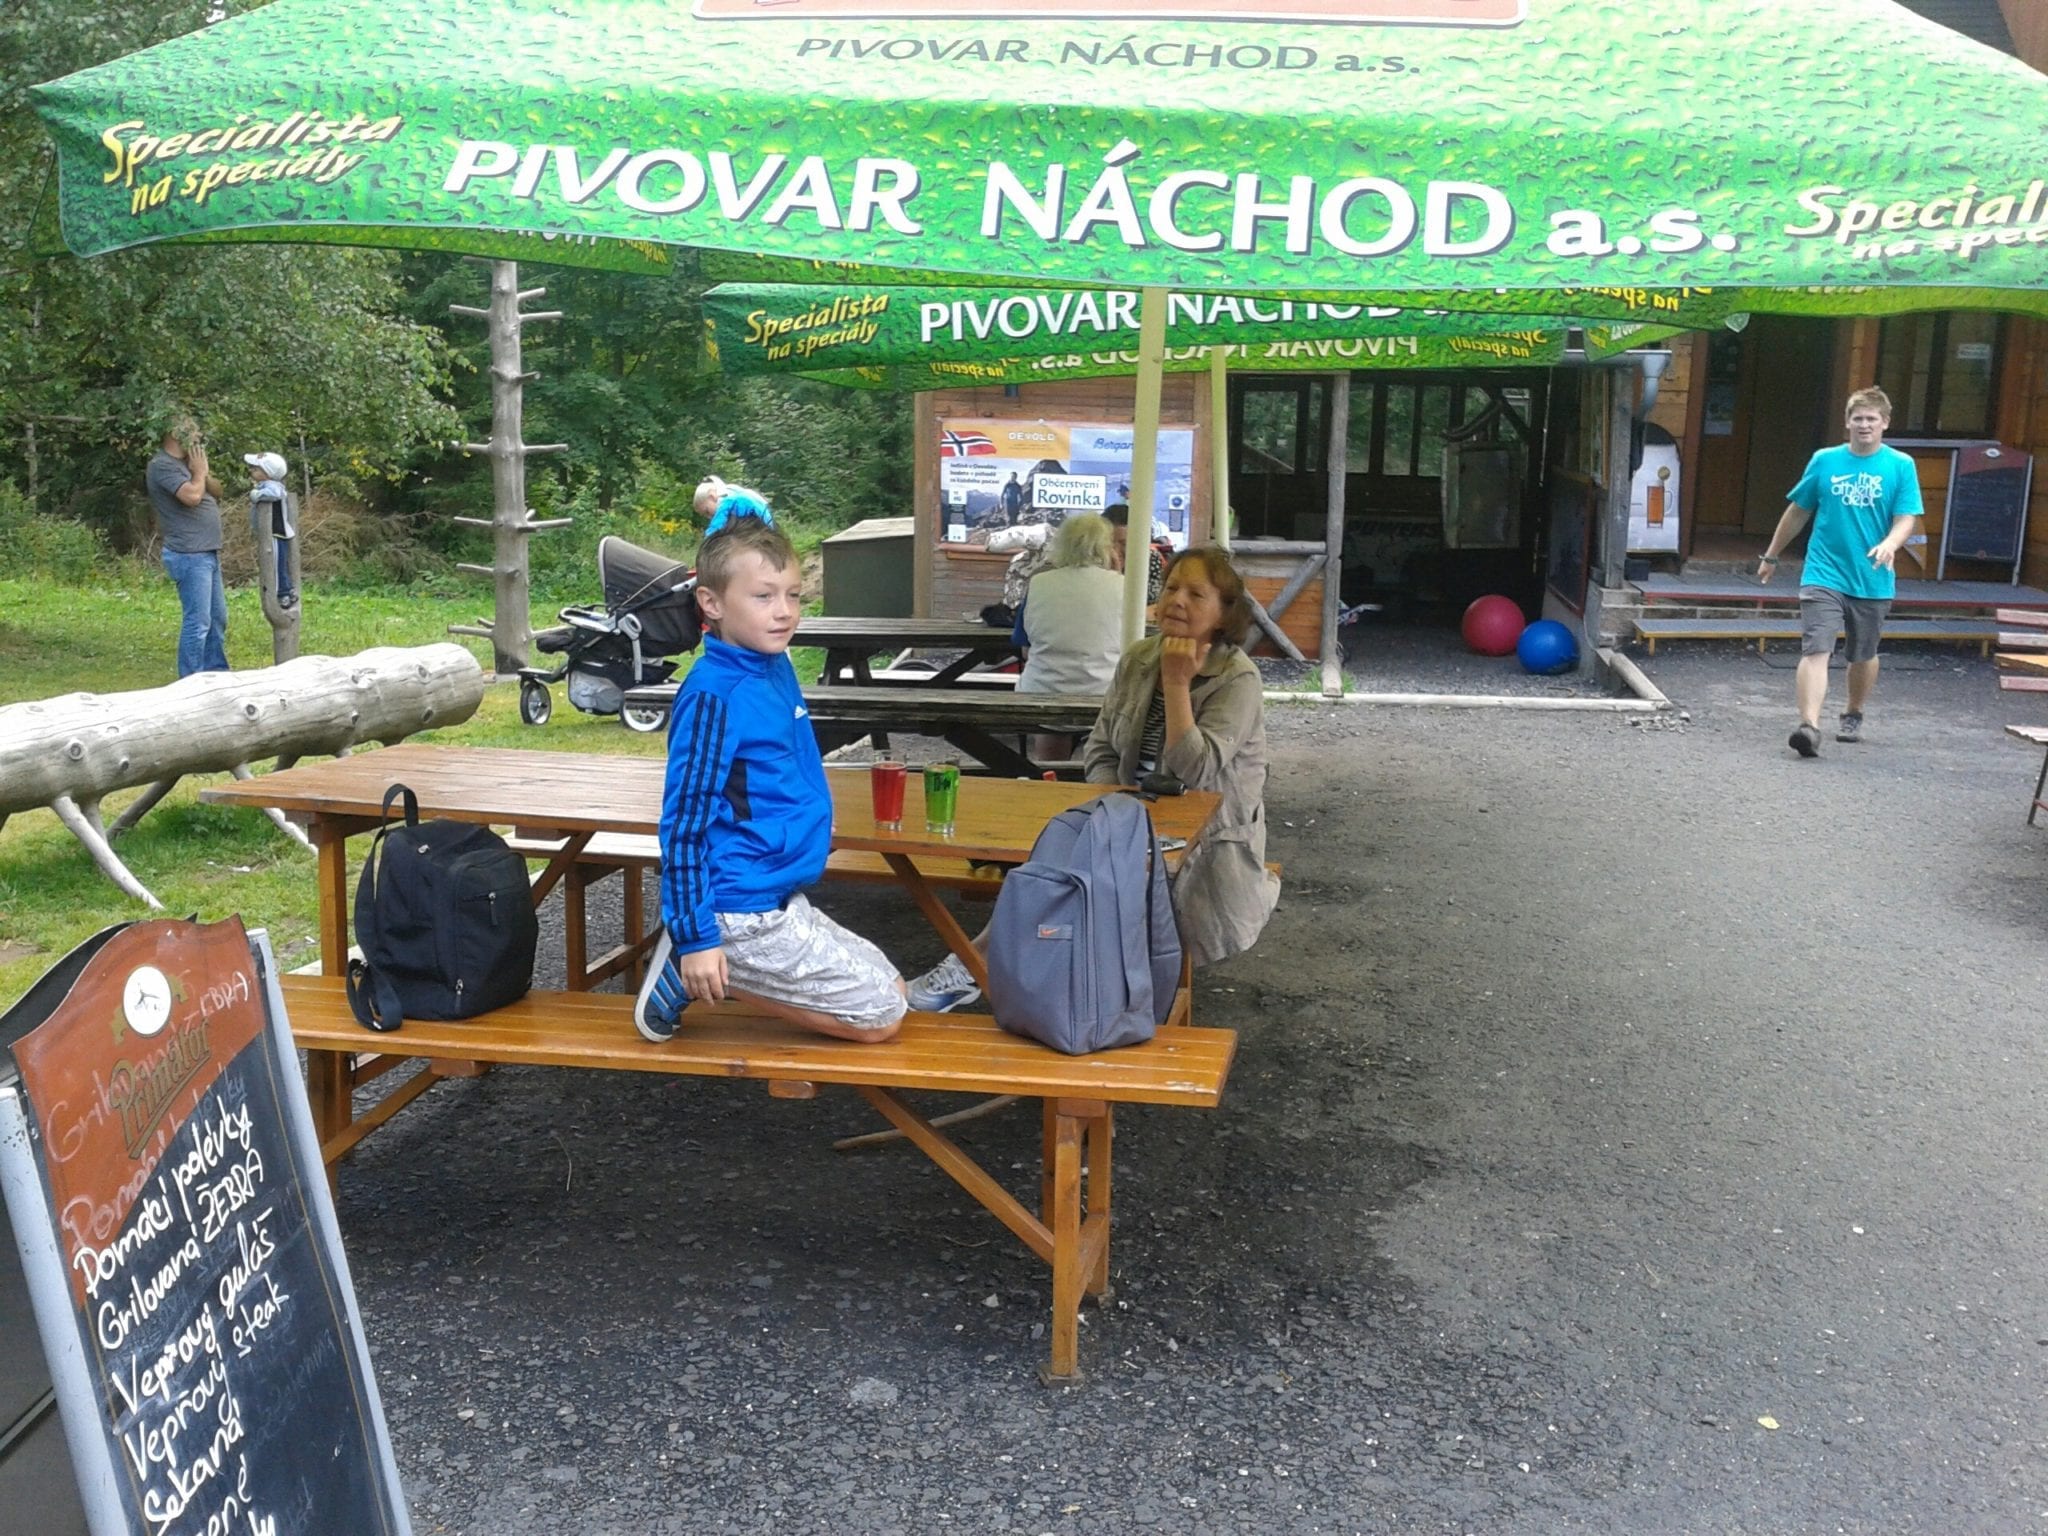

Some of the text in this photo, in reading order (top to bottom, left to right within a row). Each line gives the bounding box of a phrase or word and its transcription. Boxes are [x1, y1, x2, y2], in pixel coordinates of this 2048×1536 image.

[797, 35, 1422, 75] PIVOVAR NÁCHOD a.s.
[101, 110, 402, 185] Specialista
[131, 147, 365, 214] na speciály
[443, 137, 1737, 259] PIVOVAR NÁCHOD a.s.
[1784, 180, 2048, 245] Special
[744, 292, 889, 346] Specialista
[768, 320, 879, 361] na speciály
[921, 291, 1141, 343] PIVOVAR
[1092, 438, 1135, 453] Bergan
[1037, 489, 1101, 506] Rovinka
[108, 1019, 213, 1160] Primátor
[73, 1175, 174, 1299] Domácí
[171, 1095, 253, 1223] polévky
[97, 1222, 201, 1350] Grilovaná
[195, 1148, 264, 1244] ŽEBRA
[218, 1207, 276, 1320] guláš
[232, 1272, 290, 1359] steak
[143, 1405, 245, 1523] Sekaná
